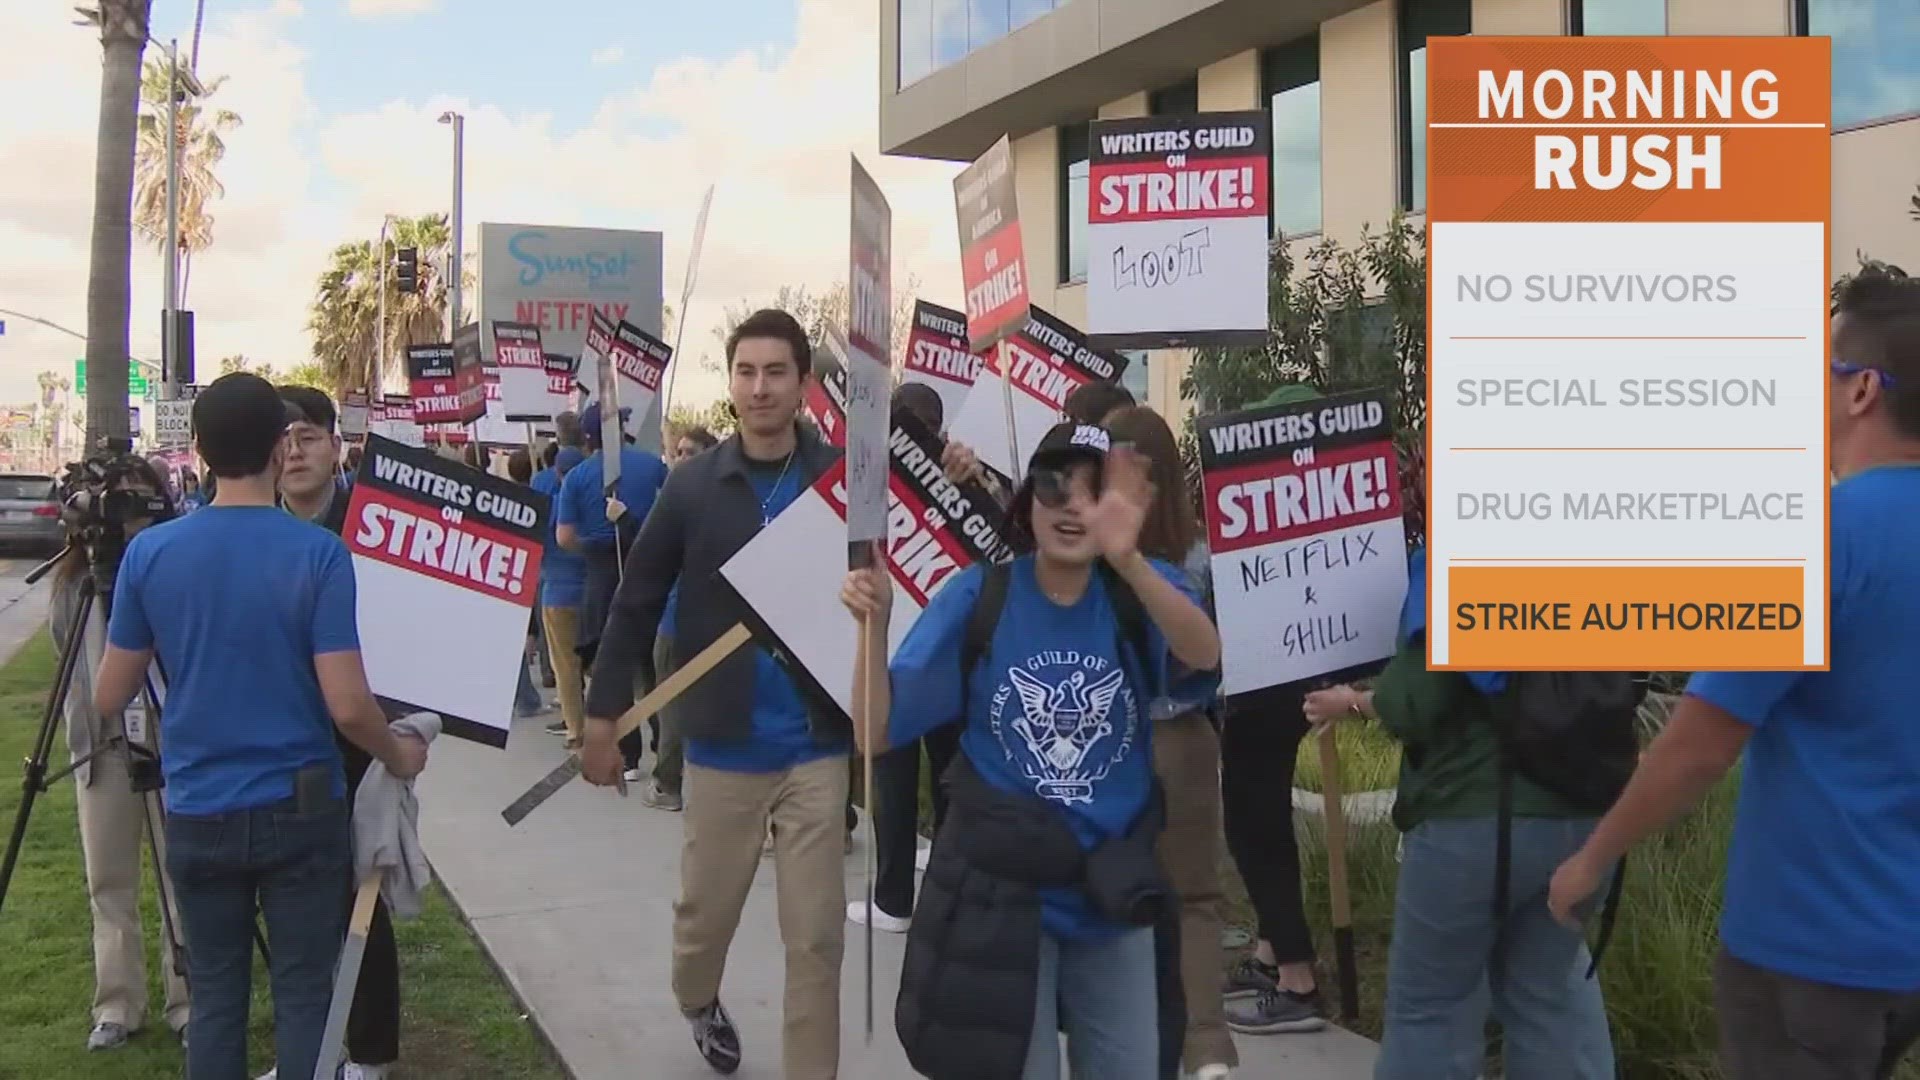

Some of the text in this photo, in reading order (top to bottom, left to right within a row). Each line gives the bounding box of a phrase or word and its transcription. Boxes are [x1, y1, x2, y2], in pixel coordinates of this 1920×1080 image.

[1101, 127, 1254, 155] WRITERS GUILD
[1166, 154, 1186, 168] ON
[1100, 167, 1255, 216] STRIKE!
[1113, 227, 1210, 291] LOOT
[968, 259, 1022, 322] STRIKE!
[919, 311, 965, 337] WRITERS
[995, 342, 1082, 408] STRIK
[1074, 348, 1114, 379] GUILD
[156, 419, 190, 430] BLOCK
[1209, 401, 1383, 454] WRITERS GUILD
[890, 426, 972, 520] WRITERS
[1292, 446, 1314, 467] ON
[375, 454, 537, 529] WRITERS GUILD
[441, 505, 464, 524] ON
[1217, 457, 1390, 539] STRIKE!
[924, 507, 947, 530] ON
[356, 503, 528, 594] STRIKE!
[1241, 531, 1378, 592] NETFLIX
[1283, 612, 1359, 657] SHILL
[990, 684, 1013, 760] ITERS
[1027, 651, 1080, 671] GUILD
[1083, 655, 1108, 672] OF
